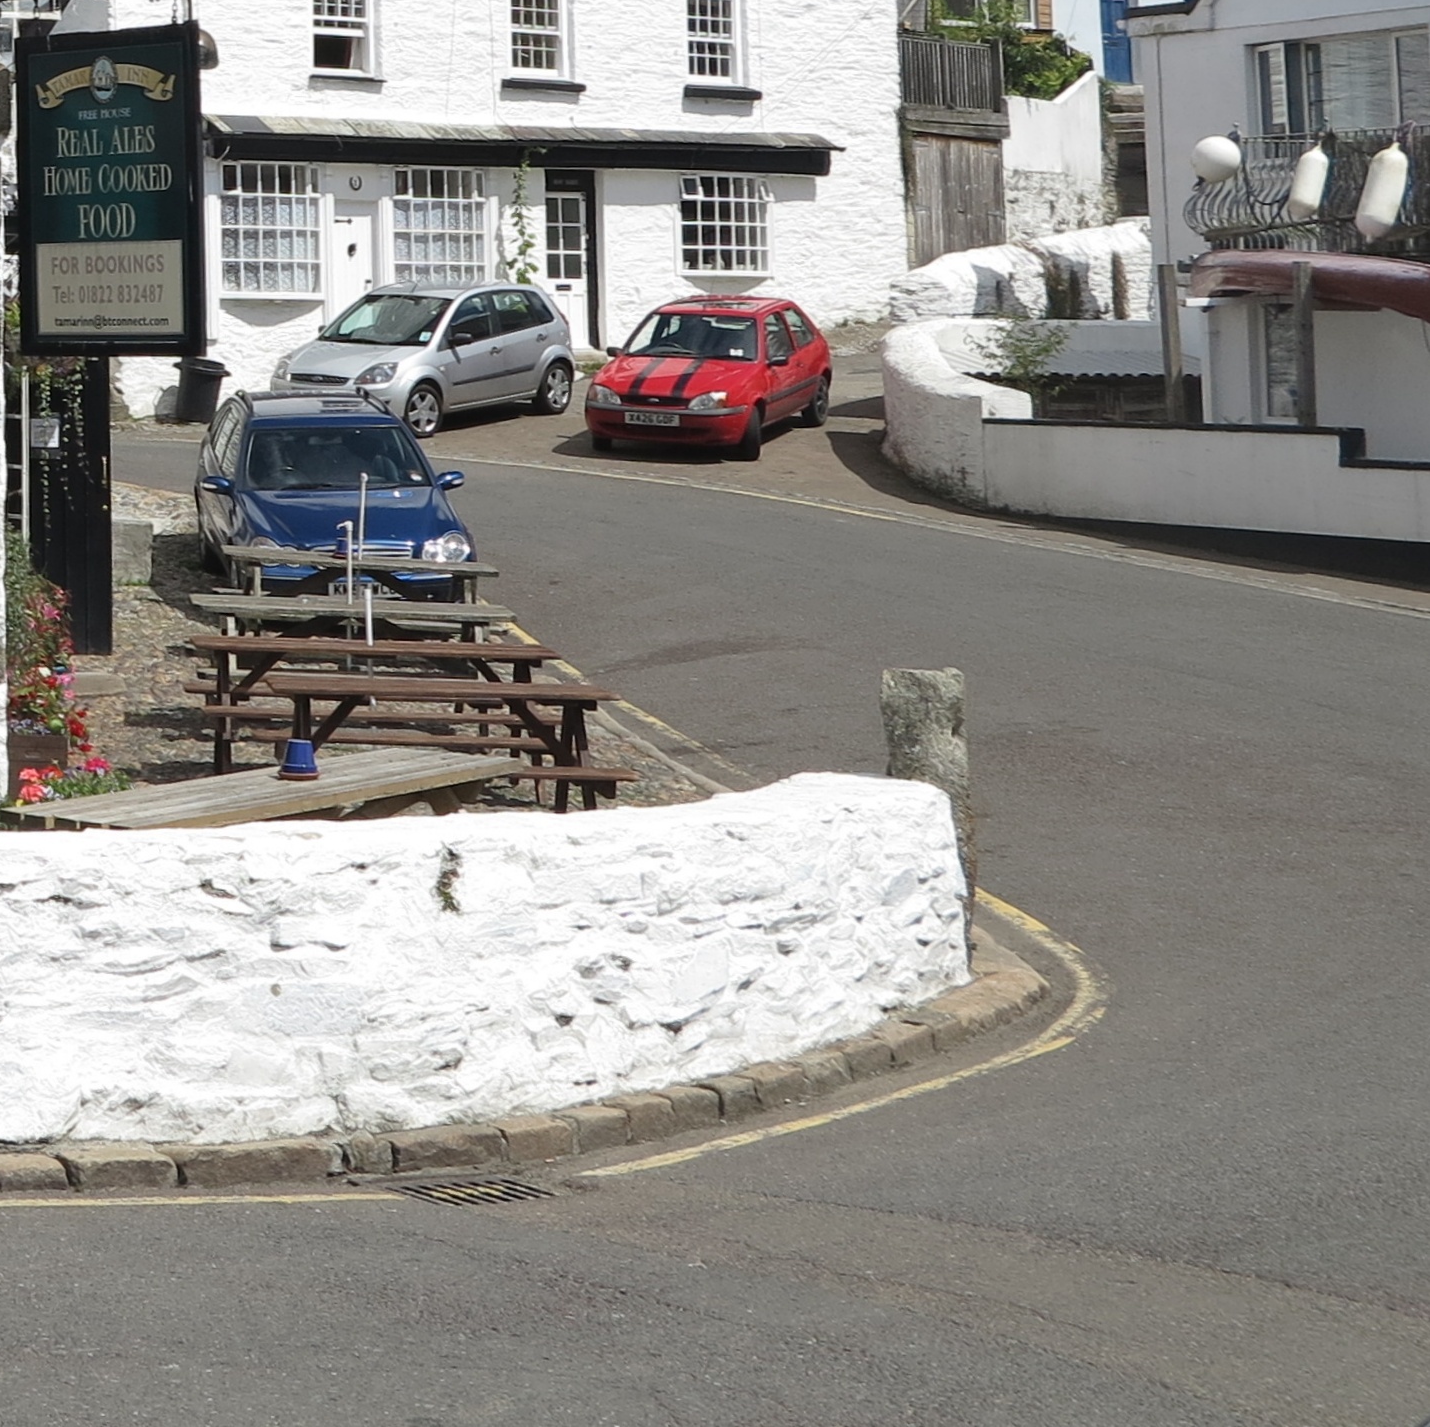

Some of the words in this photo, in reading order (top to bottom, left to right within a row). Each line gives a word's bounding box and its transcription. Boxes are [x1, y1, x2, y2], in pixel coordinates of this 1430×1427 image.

[128, 68, 150, 84] INN
[78, 110, 98, 121] FREE
[100, 108, 132, 119] HOUSE
[56, 127, 104, 158] REAL
[108, 124, 156, 155] ALES
[43, 166, 92, 196] HOME
[98, 163, 172, 193] COOKED
[77, 202, 136, 239] FOOD
[51, 256, 80, 275] FOR
[85, 254, 165, 274] BOOKINGS
[52, 285, 75, 304] Tel:
[78, 285, 113, 304] 01822
[117, 284, 164, 303] 832487
[54, 314, 169, 330] tamarinn@btconnect.com
